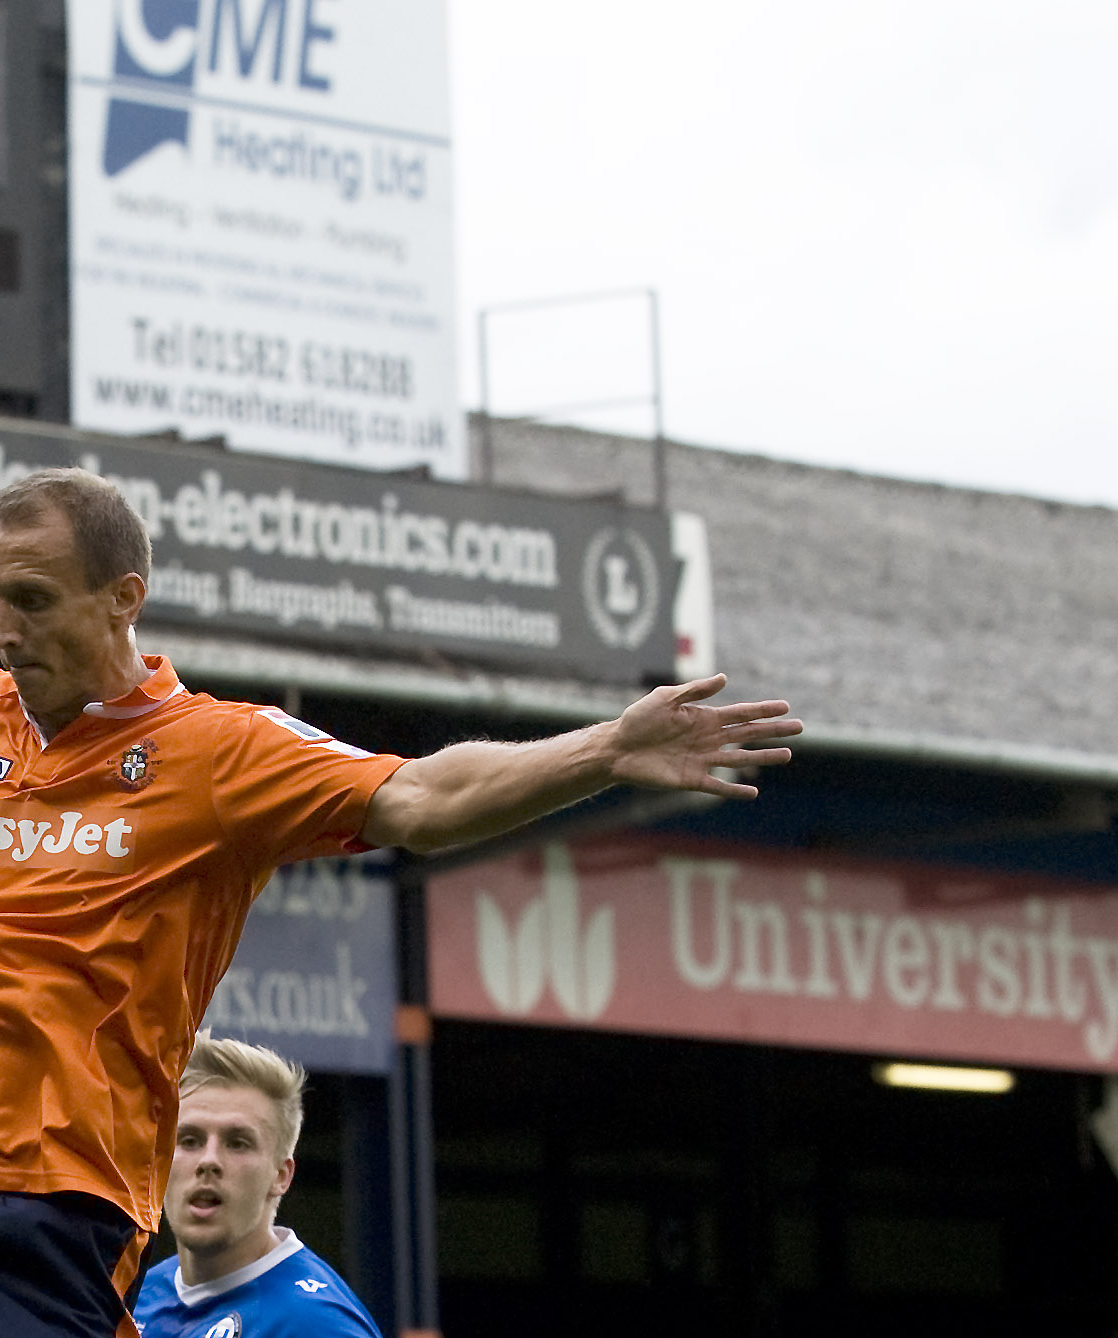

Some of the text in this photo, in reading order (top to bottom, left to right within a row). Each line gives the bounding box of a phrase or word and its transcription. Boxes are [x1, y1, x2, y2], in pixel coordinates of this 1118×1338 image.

[120, 0, 336, 93] CME
[214, 119, 426, 202] Heating Ltd
[130, 316, 180, 369] Tel
[187, 325, 291, 384] 01582
[658, 855, 1118, 1064] University
